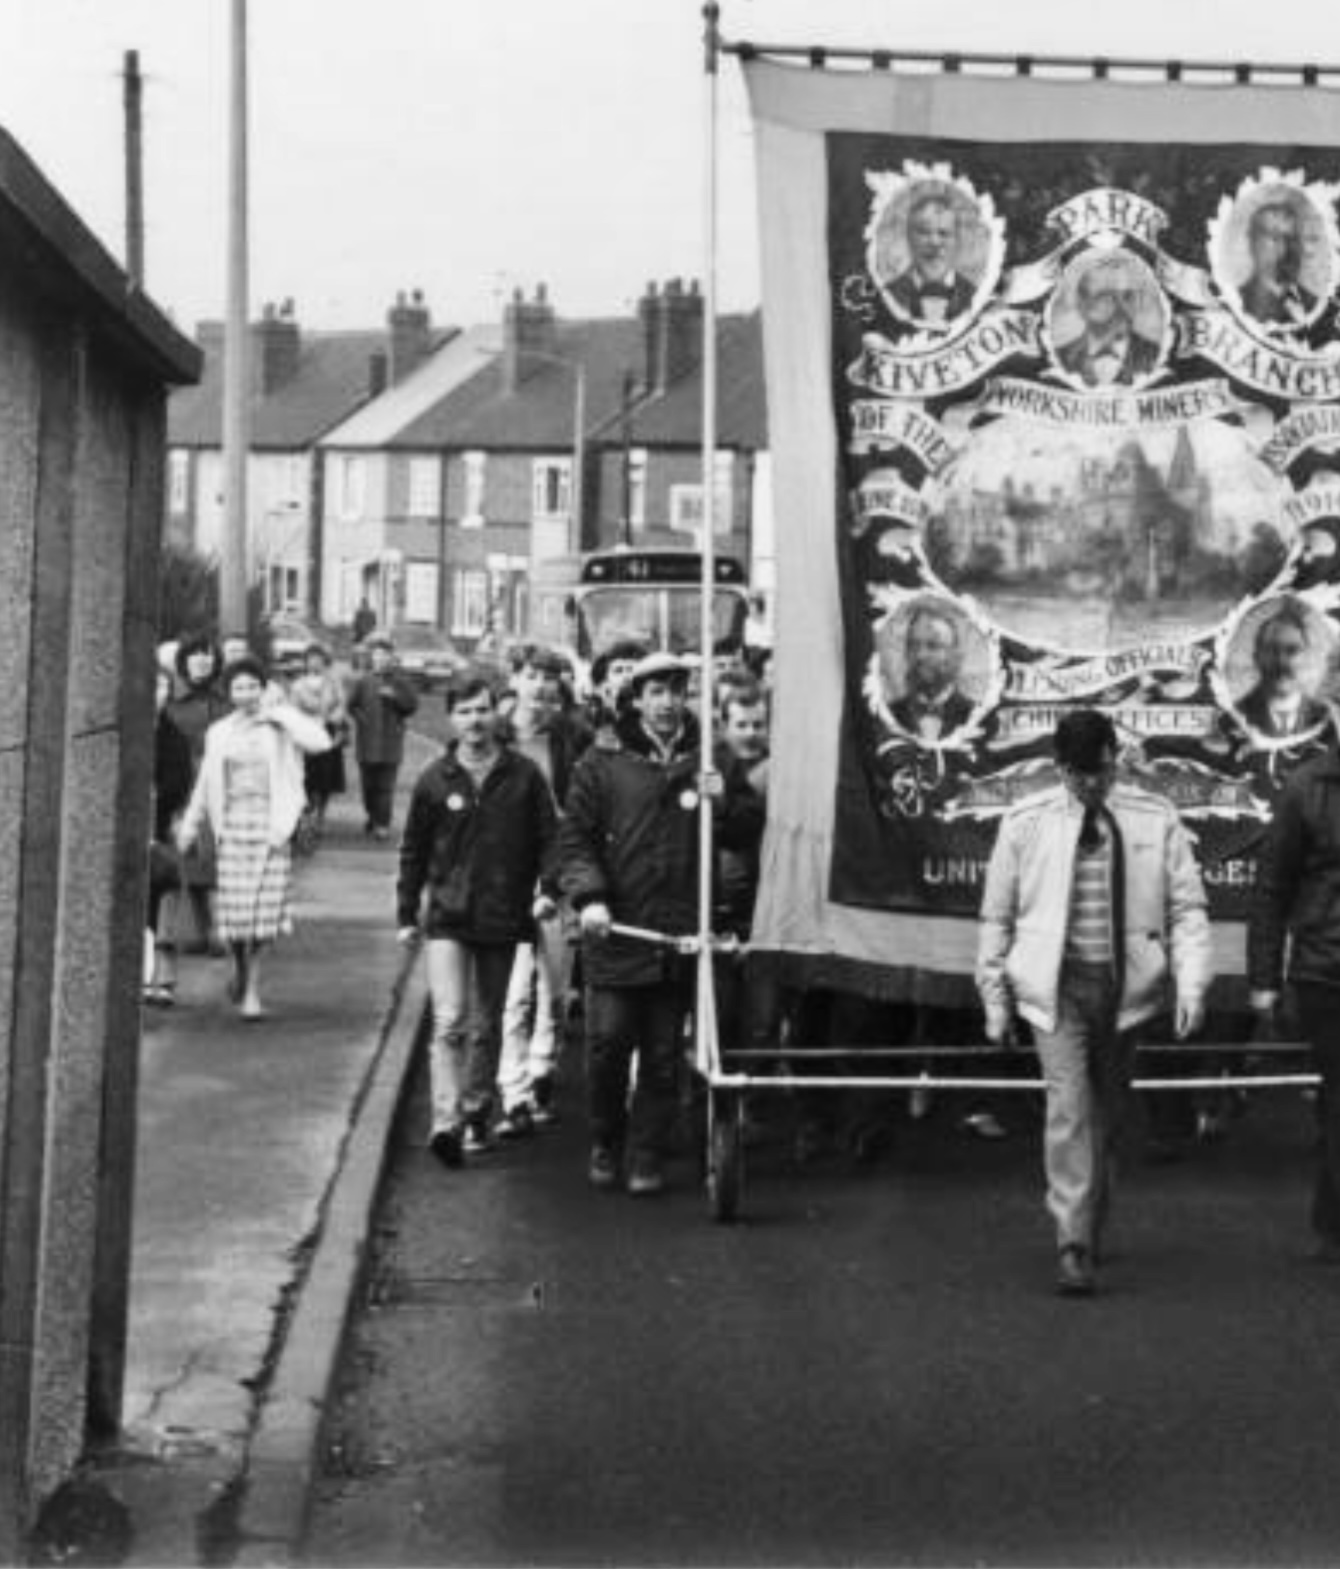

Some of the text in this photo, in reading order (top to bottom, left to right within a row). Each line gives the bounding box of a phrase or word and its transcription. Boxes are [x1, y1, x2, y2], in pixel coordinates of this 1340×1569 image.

[1053, 192, 1160, 242] PARK
[865, 313, 1031, 391] KIVETON
[901, 411, 955, 468] THE
[1114, 708, 1205, 730] FFICES
